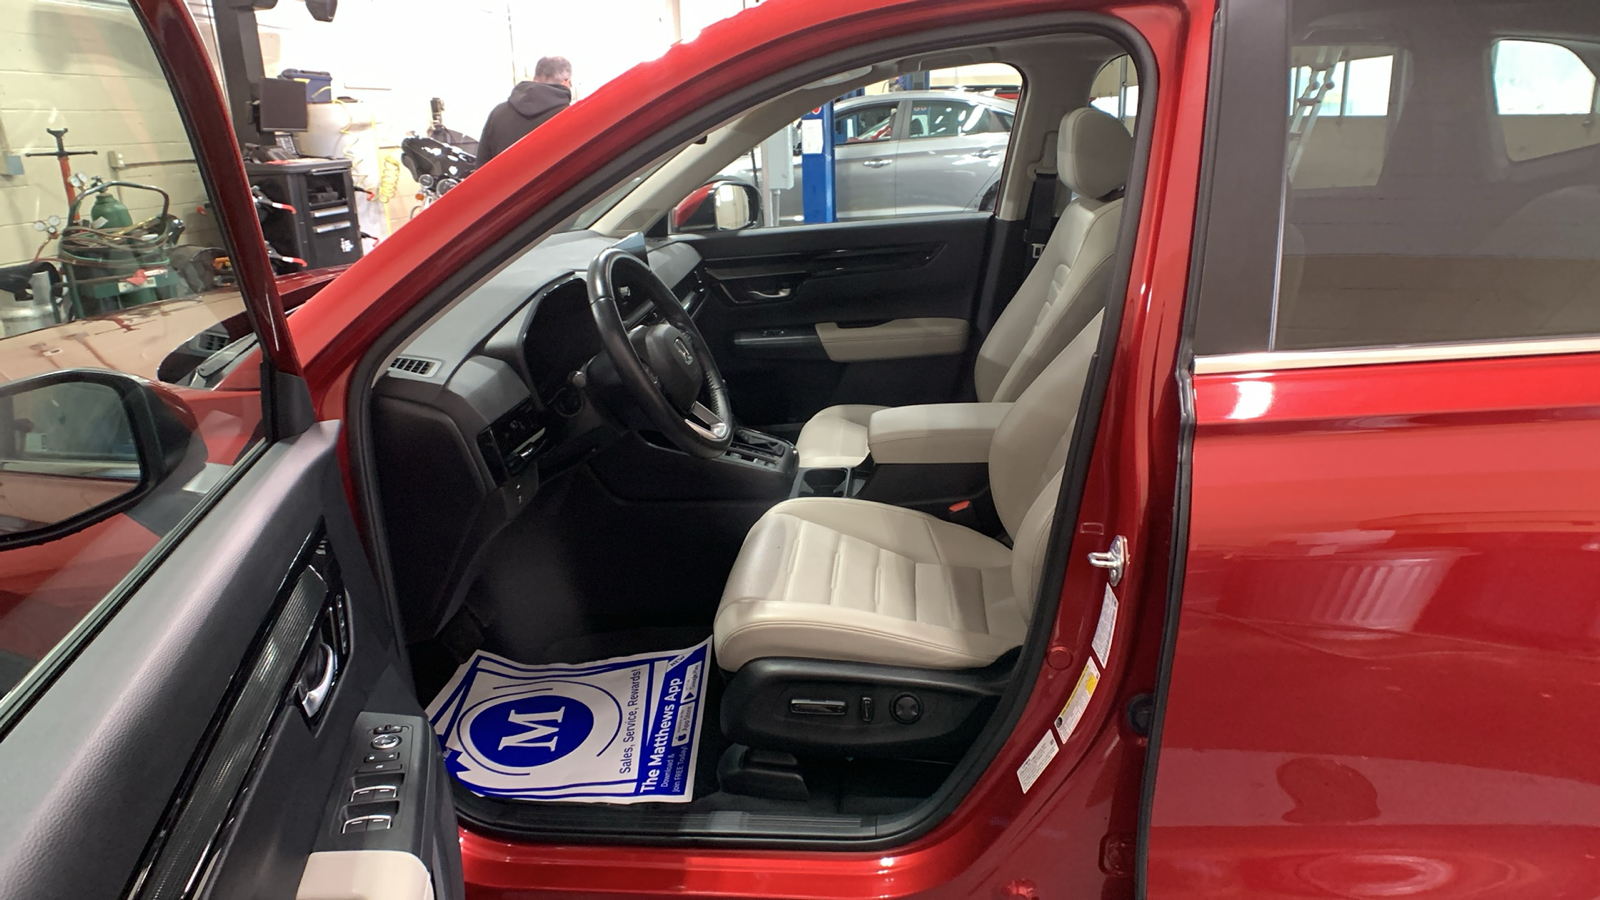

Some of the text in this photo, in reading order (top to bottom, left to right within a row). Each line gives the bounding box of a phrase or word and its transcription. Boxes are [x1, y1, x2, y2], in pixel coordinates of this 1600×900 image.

[670, 655, 685, 667] NEW
[498, 706, 566, 752] M
[619, 668, 642, 774] Sales, Service, Rewards!
[682, 719, 691, 732] App
[640, 678, 683, 793] The Matthews App
[660, 759, 674, 787] Download
[674, 765, 684, 781] FREE
[671, 780, 681, 792] Join
